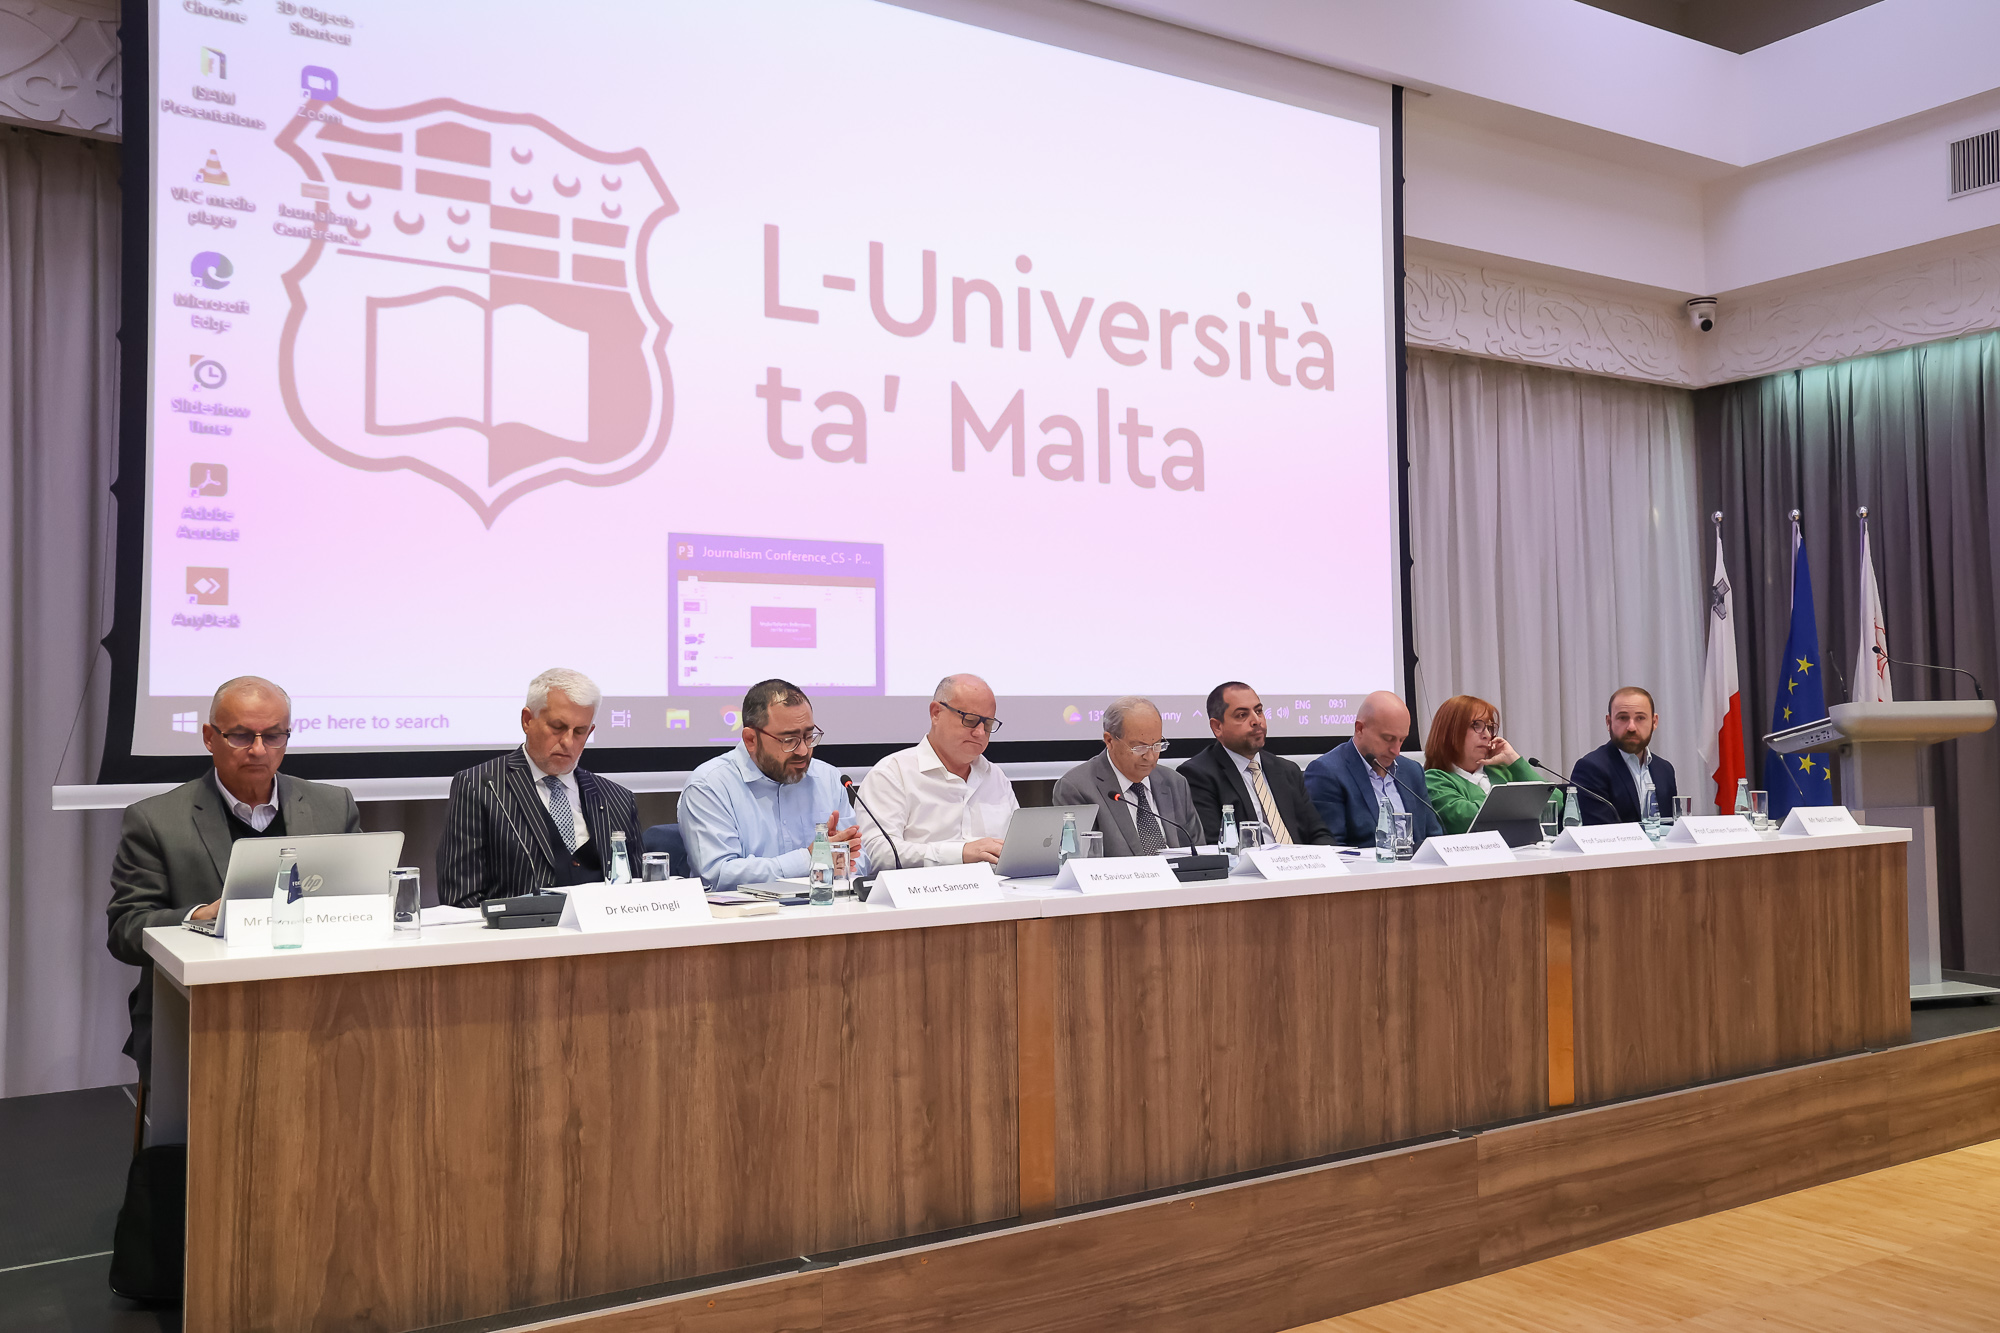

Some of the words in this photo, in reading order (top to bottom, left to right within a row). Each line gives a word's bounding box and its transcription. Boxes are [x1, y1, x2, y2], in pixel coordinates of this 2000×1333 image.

[299, 5, 355, 28] Objects
[289, 21, 352, 46] Shortcut
[160, 98, 267, 130] Presentations
[298, 104, 343, 126] Zoom
[170, 186, 204, 204] VLC
[205, 195, 257, 213] media
[187, 210, 238, 229] player
[278, 202, 358, 228] Journalism
[172, 292, 250, 315] Microsoft
[763, 222, 1335, 393] L-Università
[191, 314, 232, 334] Edge
[171, 397, 251, 418] Slideshow
[188, 420, 233, 436] Timer
[755, 366, 901, 464] ta'
[950, 380, 1206, 493] Malta
[181, 506, 235, 522] Adobe
[176, 525, 240, 542] Acrobat
[702, 546, 763, 561] Journalism
[765, 548, 846, 566] Conference_CS
[171, 612, 242, 632] AnyDesk
[1294, 699, 1312, 710] ENG
[1328, 698, 1348, 709] 09:51
[291, 717, 322, 733] ype
[327, 714, 366, 729] here
[372, 715, 390, 729] to
[395, 714, 450, 729] search
[1298, 714, 1310, 725] US
[1453, 843, 1480, 852] Matthew
[1270, 856, 1291, 864] Judge
[1292, 853, 1322, 862] Emeritus
[1276, 863, 1304, 872] Michael
[1090, 874, 1102, 882] Mr
[1104, 872, 1133, 881] Saviour
[1134, 871, 1160, 879] Balzan
[907, 886, 921, 895] Mr
[923, 884, 941, 894] Kurt
[943, 881, 979, 892] Sansone
[605, 906, 618, 915] Dr
[620, 902, 649, 915] Kevin
[651, 900, 681, 913] Dingli
[243, 916, 262, 927] Mr
[316, 912, 373, 923] Mercieca
